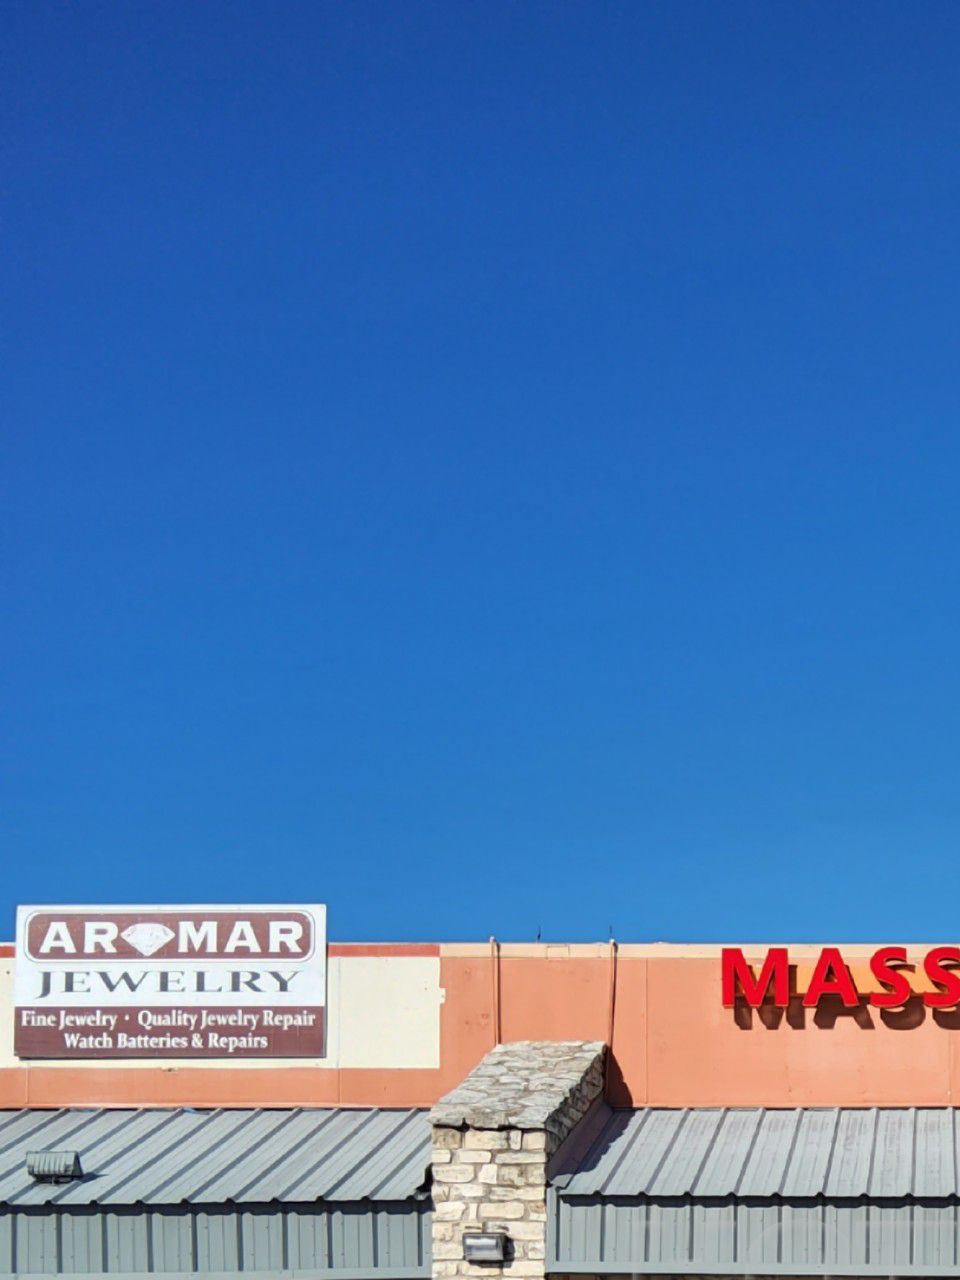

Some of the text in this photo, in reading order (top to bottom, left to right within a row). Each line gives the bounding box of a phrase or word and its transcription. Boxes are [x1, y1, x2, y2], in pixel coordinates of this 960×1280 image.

[34, 970, 304, 999] JEWELRY
[21, 1010, 316, 1031] Fine Jewelry Quality Jewelry Repair
[64, 1032, 269, 1053] Watch Batteries & Repairs
